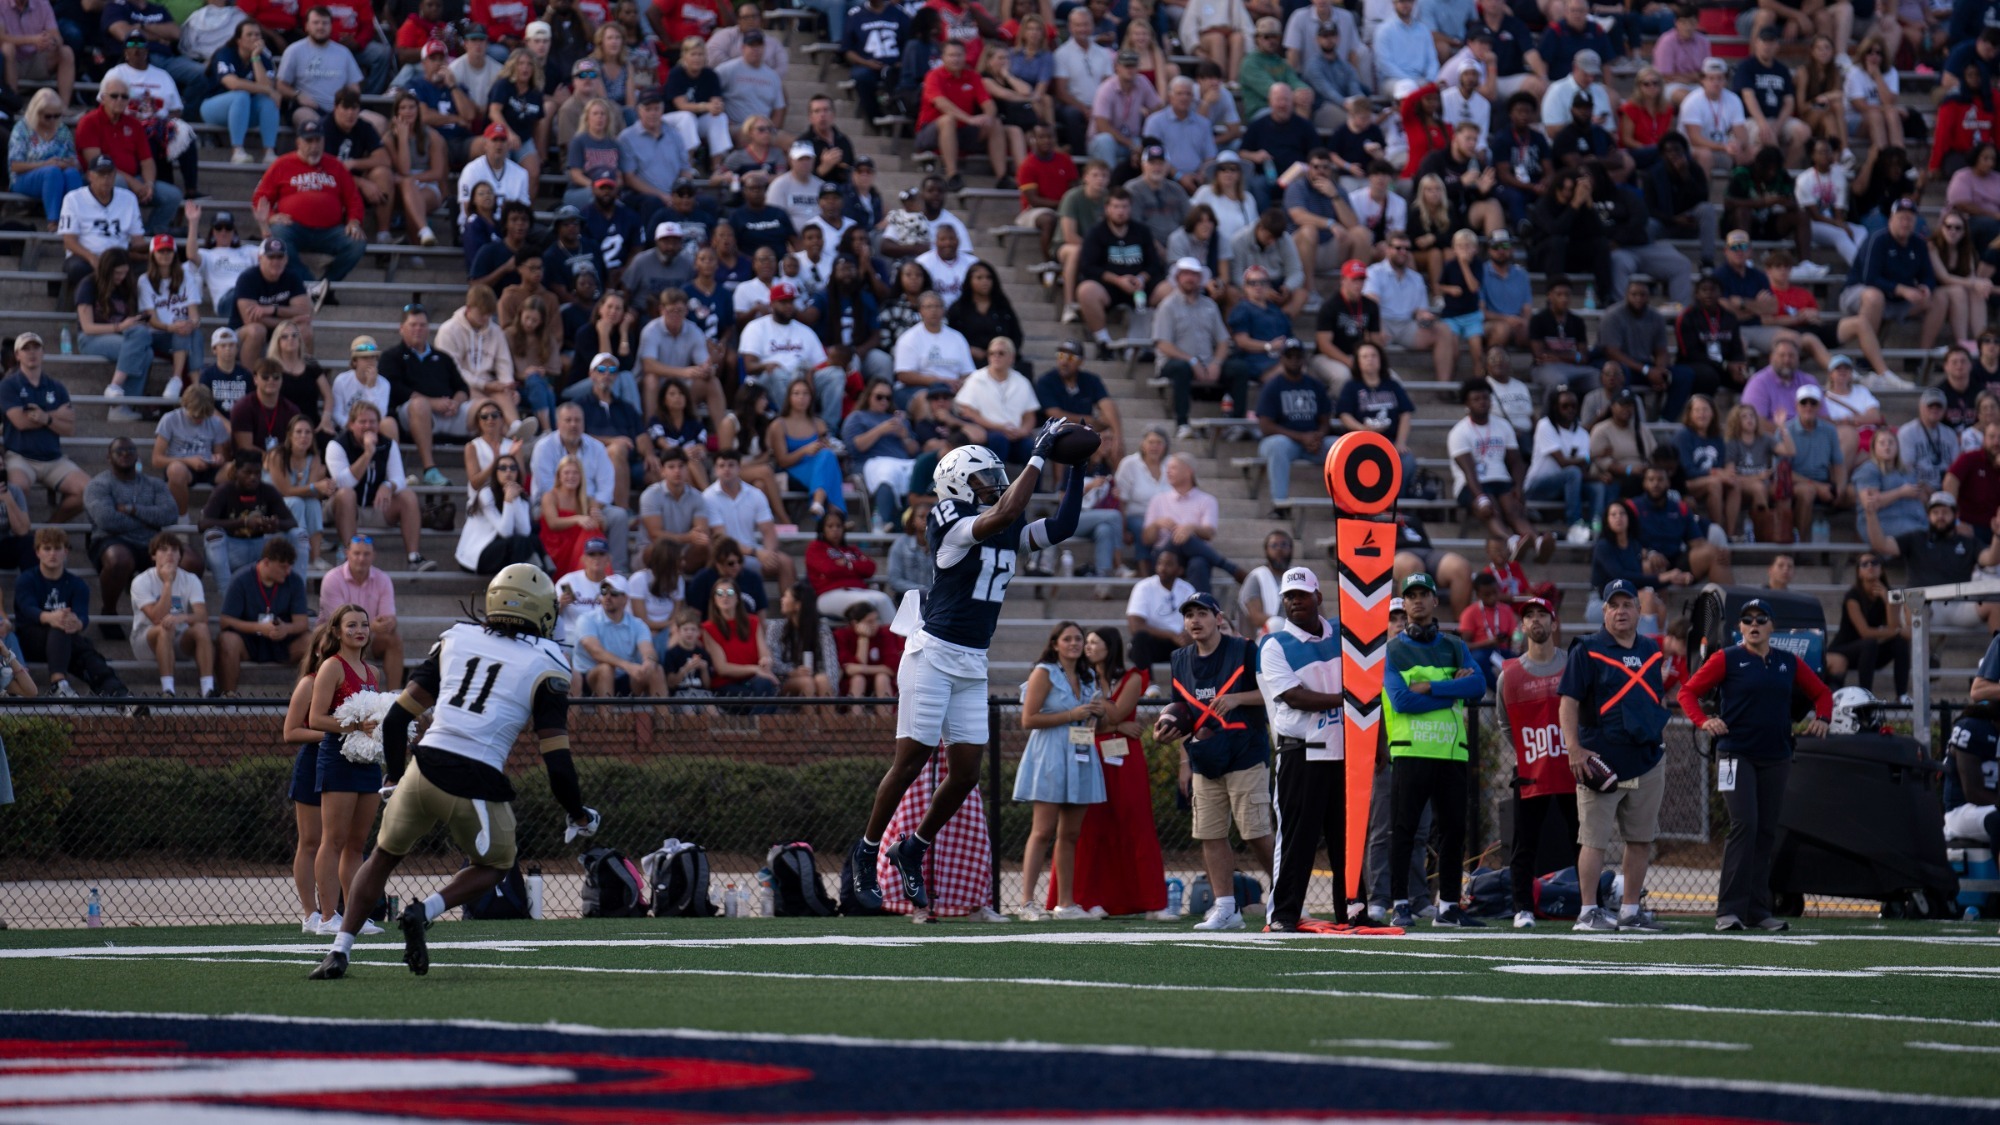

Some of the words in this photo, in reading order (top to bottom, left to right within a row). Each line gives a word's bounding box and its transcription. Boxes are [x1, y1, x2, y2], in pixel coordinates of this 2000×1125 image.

[864, 29, 900, 58] 42
[290, 171, 337, 188] SAMFORD
[600, 234, 624, 269] 2
[931, 500, 959, 527] 12
[971, 546, 1017, 603] 12
[1769, 637, 1811, 649] OWER
[448, 656, 503, 715] 11
[1410, 720, 1457, 733] INSTANT
[1413, 731, 1456, 744] REPLAY
[1950, 726, 1971, 749] 22
